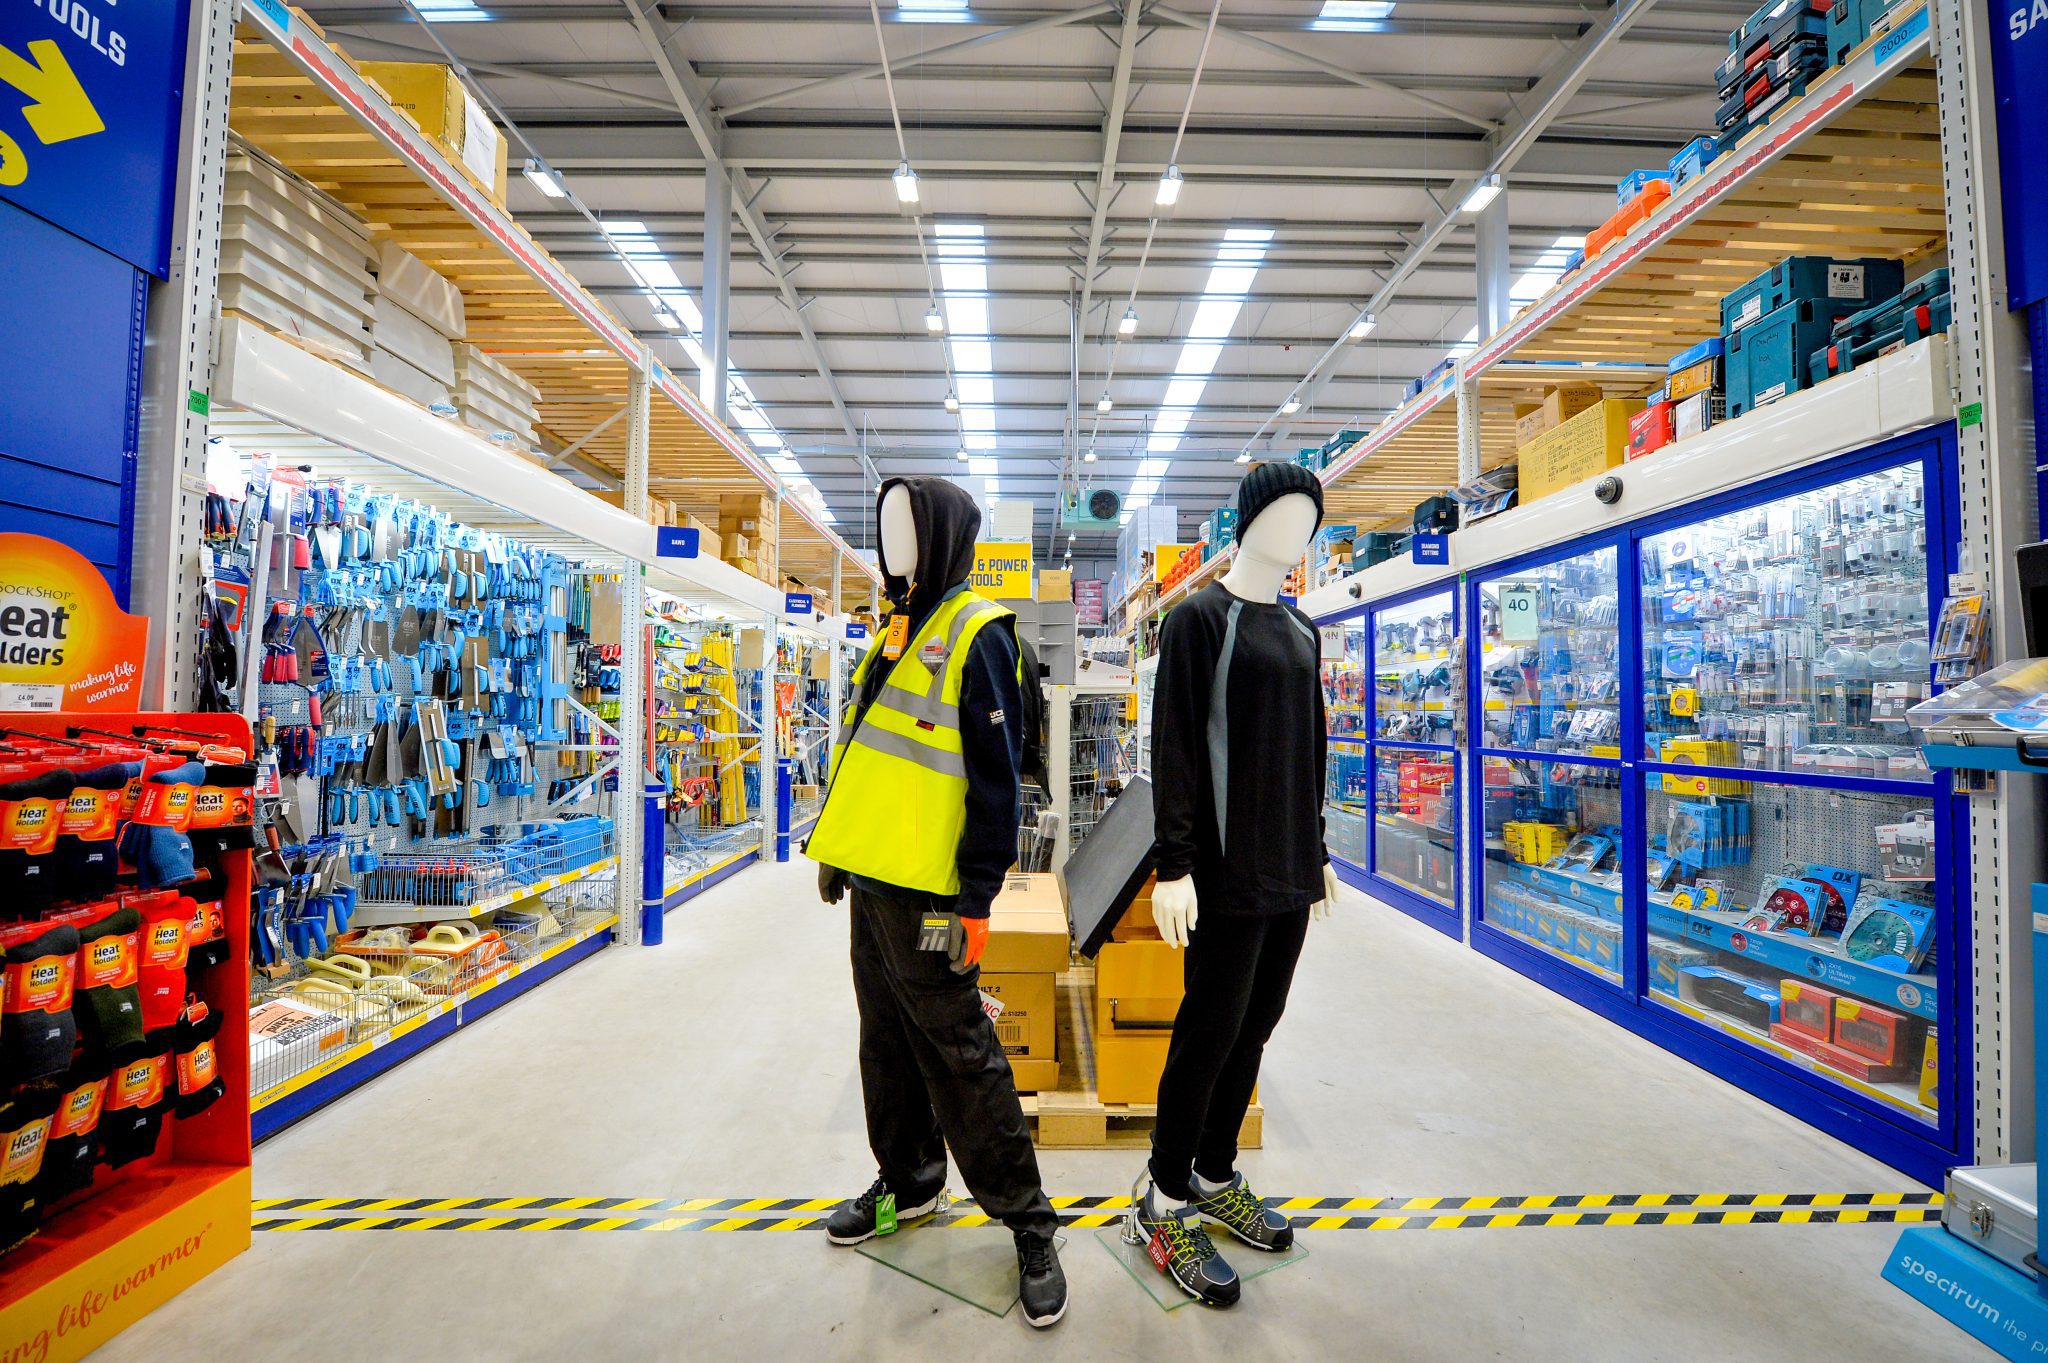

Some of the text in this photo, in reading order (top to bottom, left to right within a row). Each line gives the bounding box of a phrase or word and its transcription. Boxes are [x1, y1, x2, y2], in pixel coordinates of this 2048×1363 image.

[34, 0, 126, 66] OOLS
[1880, 29, 1908, 56] 2000
[363, 104, 392, 134] PLEASE
[1634, 234, 1655, 253] PLEASE
[1676, 203, 1697, 222] PLACE
[1699, 180, 1728, 203] PALLETS
[1738, 159, 1753, 176] THIS
[1755, 144, 1776, 162] RACK
[190, 395, 202, 406] 700
[1960, 410, 1973, 419] 700
[977, 558, 1028, 572] & POWER
[970, 573, 1003, 586] TOOLS
[1324, 631, 1339, 640] 4N
[70, 661, 136, 692] making life
[86, 680, 130, 704] warmer
[1419, 771, 1449, 783] Milwaukee
[66, 797, 97, 807] Heat
[170, 792, 188, 801] Heat
[19, 808, 47, 818] Heat
[1831, 871, 1855, 883] OX
[1909, 909, 1928, 918] OX
[155, 928, 178, 939] Heat
[1692, 921, 1713, 937] OX
[94, 944, 120, 958] Heat
[94, 955, 120, 966] Holders
[31, 966, 59, 979] Heat
[1828, 969, 1857, 982] ULTIMATE
[30, 977, 58, 988] Holders
[195, 1049, 211, 1066] Heat
[127, 1066, 151, 1081] Heat
[126, 1076, 150, 1088] Holders
[72, 1091, 93, 1107] Heat
[11, 1128, 42, 1151] Heat
[9, 1144, 40, 1161] Holders
[1151, 1246, 1164, 1265] SBP
[113, 1229, 206, 1301] warmer
[1901, 1255, 2001, 1324] spectrum
[2002, 1319, 2027, 1342] the
[57, 1290, 109, 1338] life
